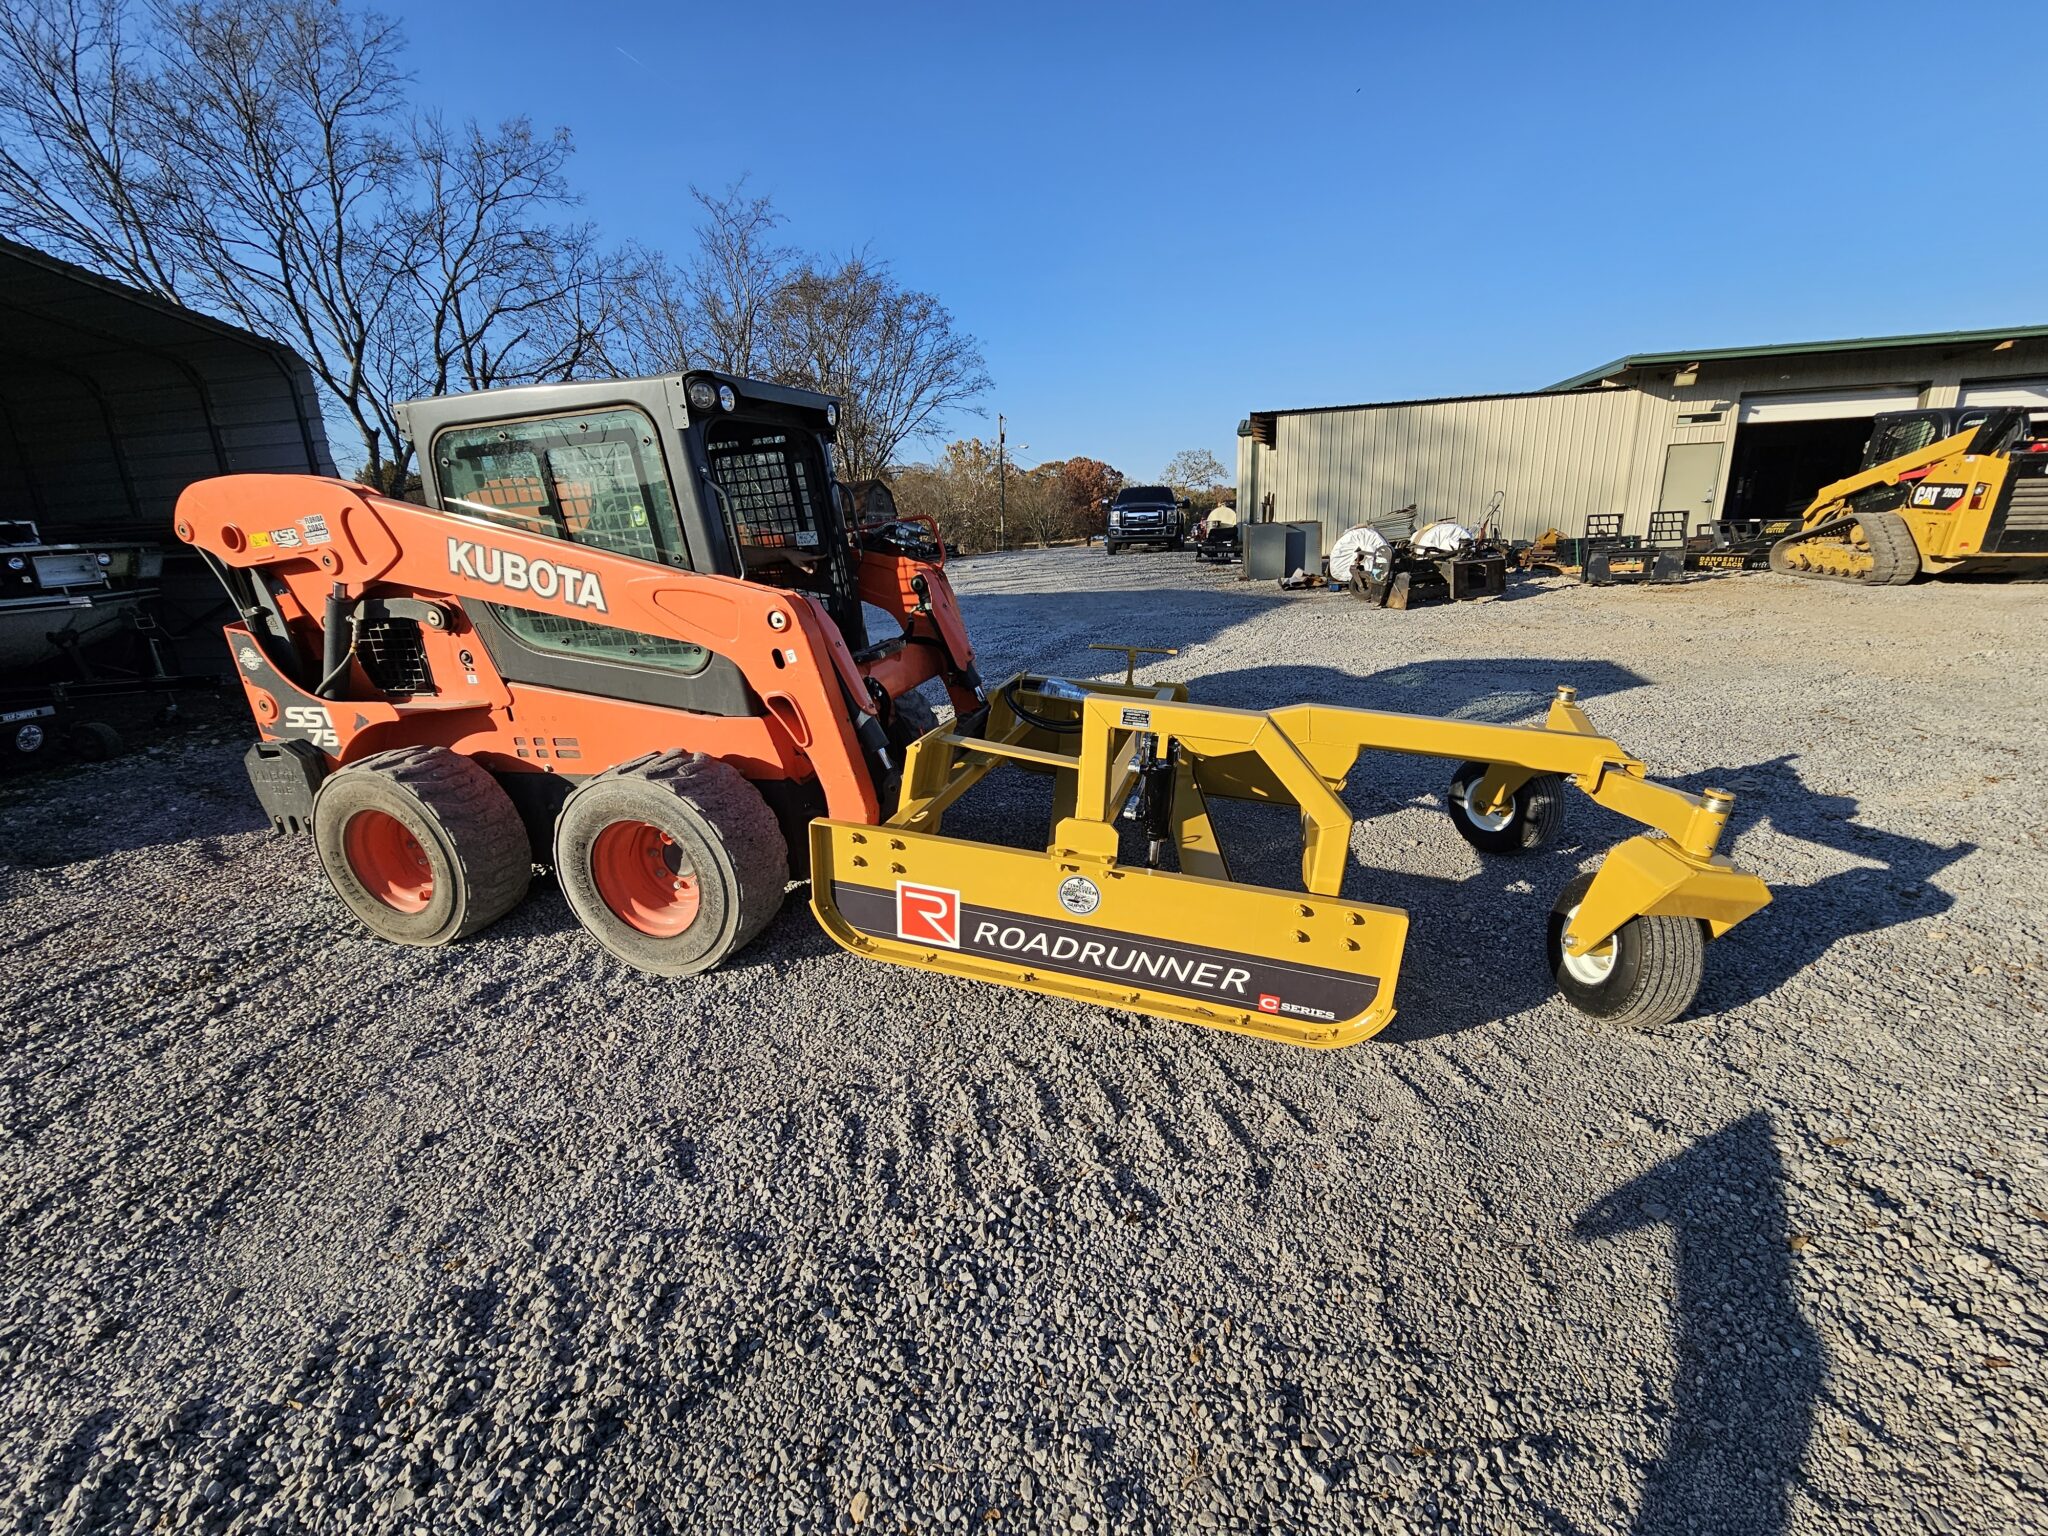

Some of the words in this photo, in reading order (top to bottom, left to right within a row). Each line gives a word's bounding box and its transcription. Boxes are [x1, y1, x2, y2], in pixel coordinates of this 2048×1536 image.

[1913, 486, 1942, 506] CAT
[270, 528, 299, 543] KSR
[1700, 556, 1745, 564] DANGER!!!
[447, 537, 608, 613] KUBOTA
[307, 729, 339, 747] 75
[973, 921, 1251, 994] ROADRUNNER
[1260, 997, 1278, 1010] C
[1280, 1002, 1336, 1020] SERIES
